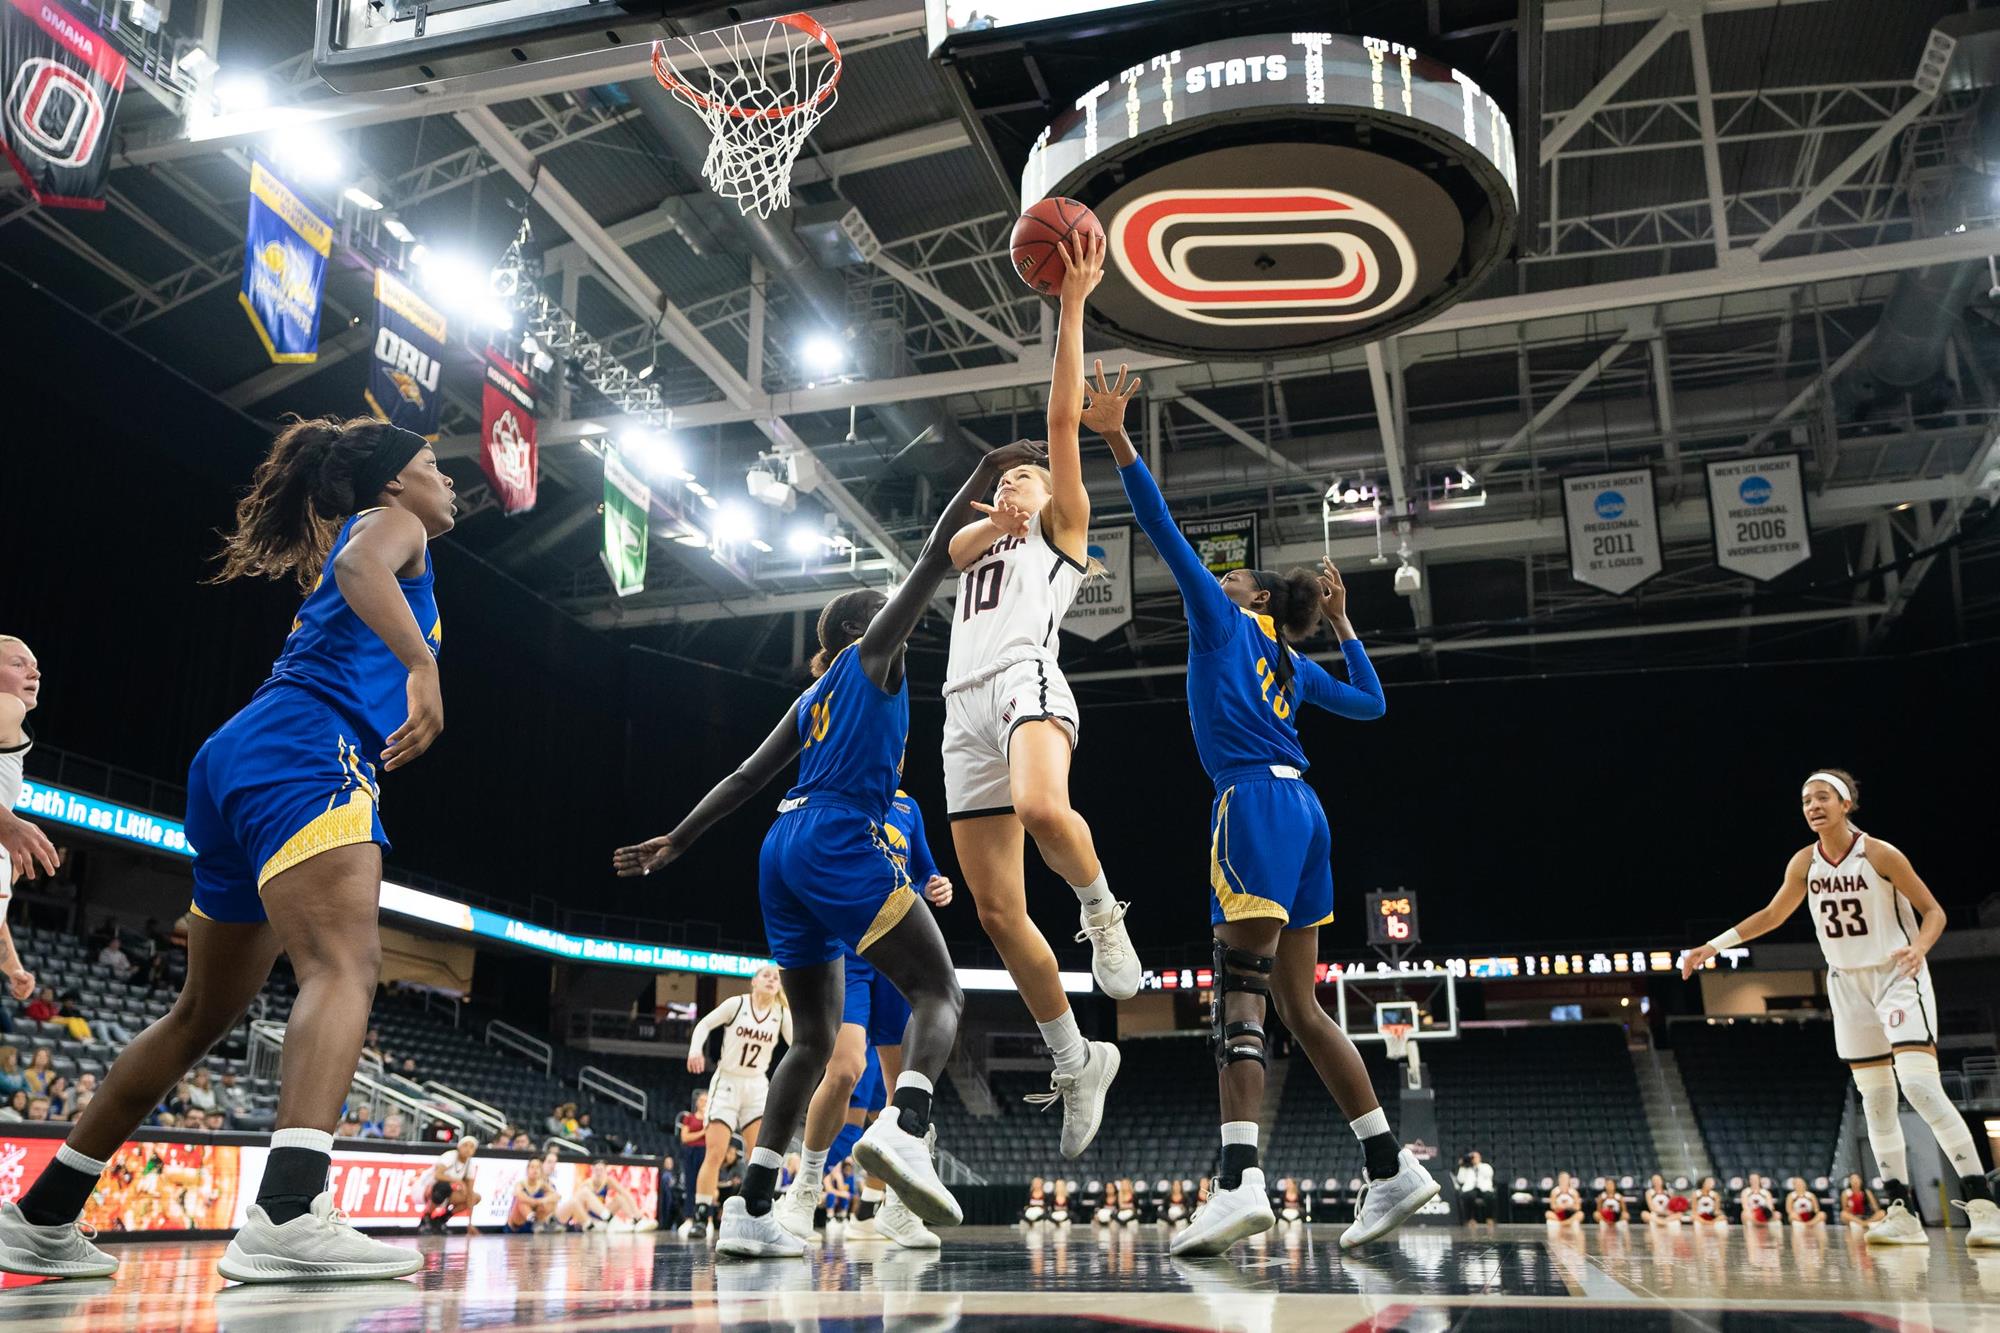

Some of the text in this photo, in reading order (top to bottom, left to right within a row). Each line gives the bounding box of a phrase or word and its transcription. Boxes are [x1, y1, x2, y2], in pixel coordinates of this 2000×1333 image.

[42, 6, 93, 55] OMAHA
[1363, 36, 1416, 60] PTS FLS
[1121, 50, 1181, 84] PTS FLS
[1186, 54, 1287, 93] STATS
[375, 326, 441, 392] ORU
[1758, 461, 1791, 472] HOCKEY
[1613, 476, 1644, 487] HOCKEY
[1729, 504, 1788, 518] REGIONAL
[1097, 531, 1123, 541] HOCKEY
[1584, 519, 1641, 533] REGIONAL
[1736, 519, 1786, 542] 2006
[1197, 536, 1249, 553] FROZEN
[1593, 533, 1635, 556] 2011
[1727, 542, 1800, 557] WORCESTER
[1590, 557, 1644, 570] ST. LOUIS
[963, 560, 1004, 622] 10
[1076, 584, 1112, 605] 2015
[1098, 606, 1125, 616] BEND
[16, 783, 187, 850] Bath in as Little as
[1810, 875, 1869, 895] OMAHA
[1820, 898, 1869, 938] 33
[583, 939, 617, 960] Bath
[618, 944, 632, 960] in
[633, 947, 652, 964] as
[653, 947, 688, 968] Little
[690, 955, 707, 969] as
[709, 953, 738, 973] ONE
[736, 1026, 774, 1042] OMAHA
[740, 1043, 762, 1068] 12
[341, 1166, 374, 1213] OF
[374, 1168, 417, 1213] THE
